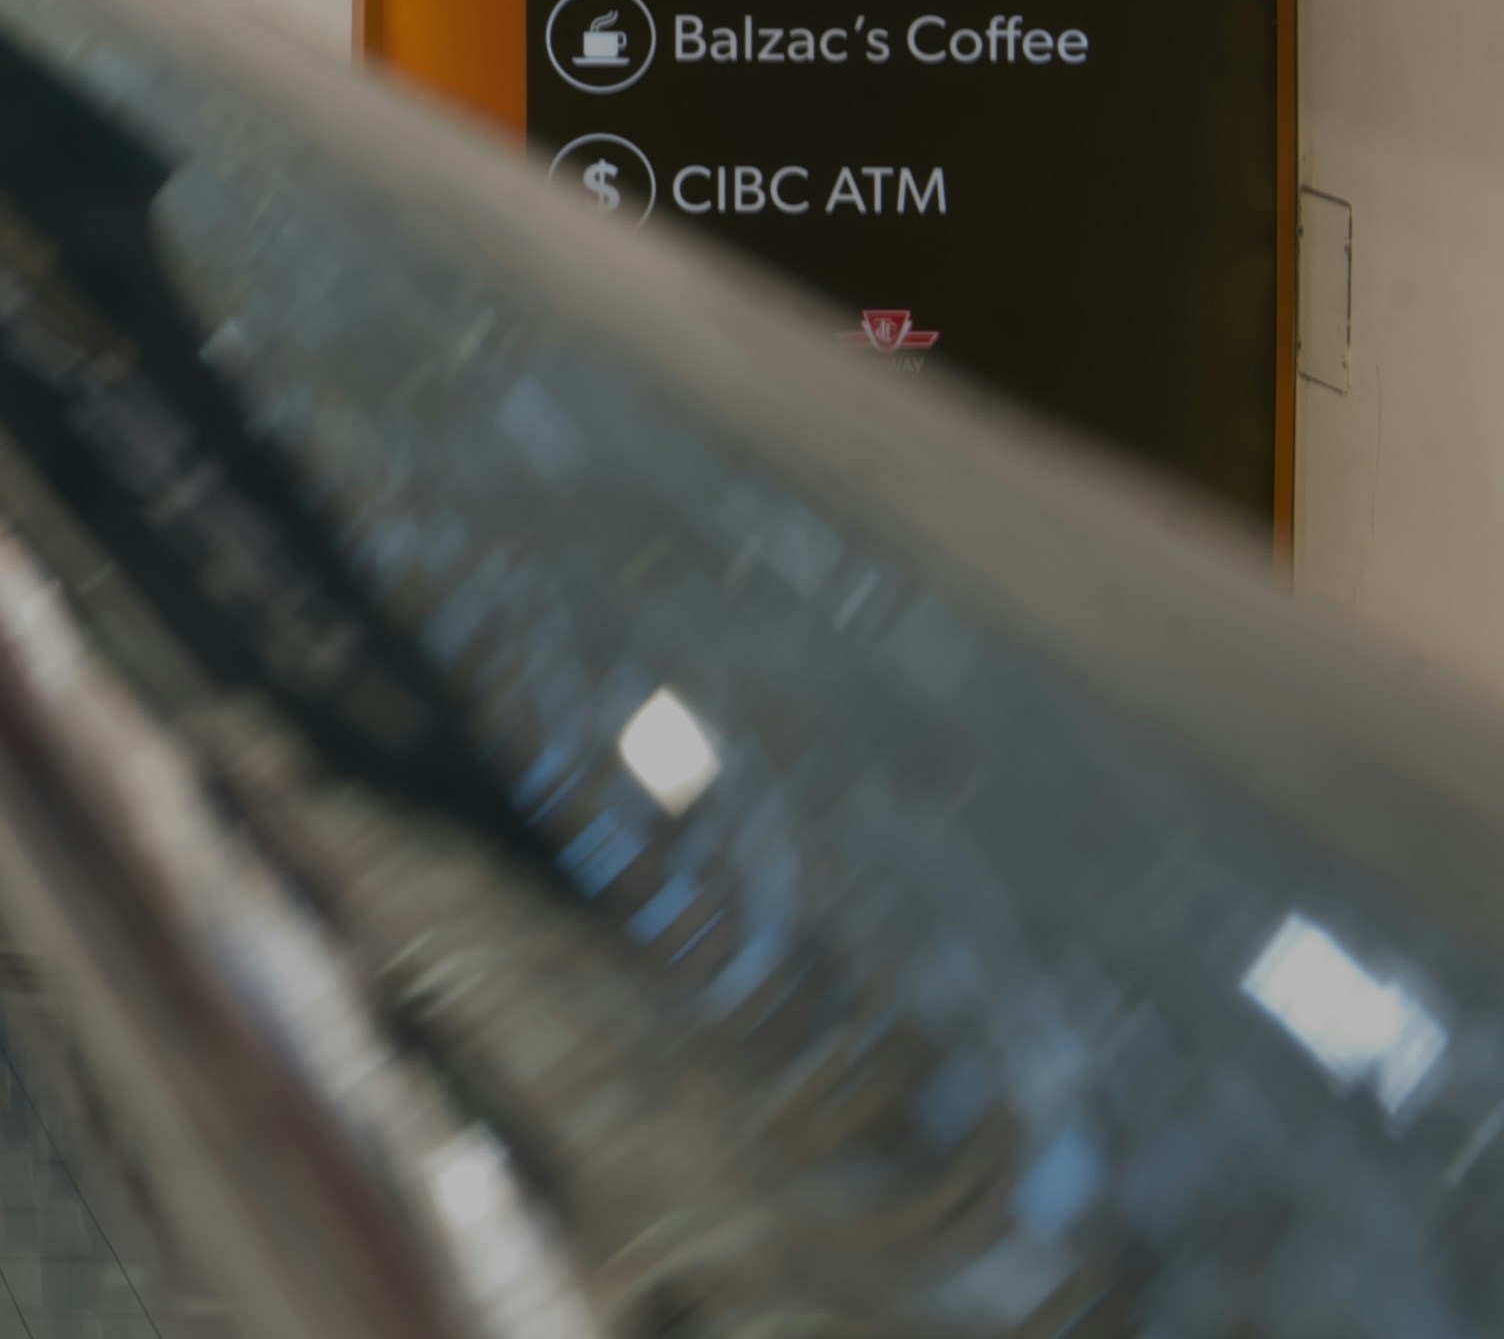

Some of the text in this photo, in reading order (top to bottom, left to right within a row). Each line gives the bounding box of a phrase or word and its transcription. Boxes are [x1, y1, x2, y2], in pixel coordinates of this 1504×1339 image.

[673, 14, 1089, 64] Balzac's Coffee
[672, 165, 947, 213] CIBC ATM
